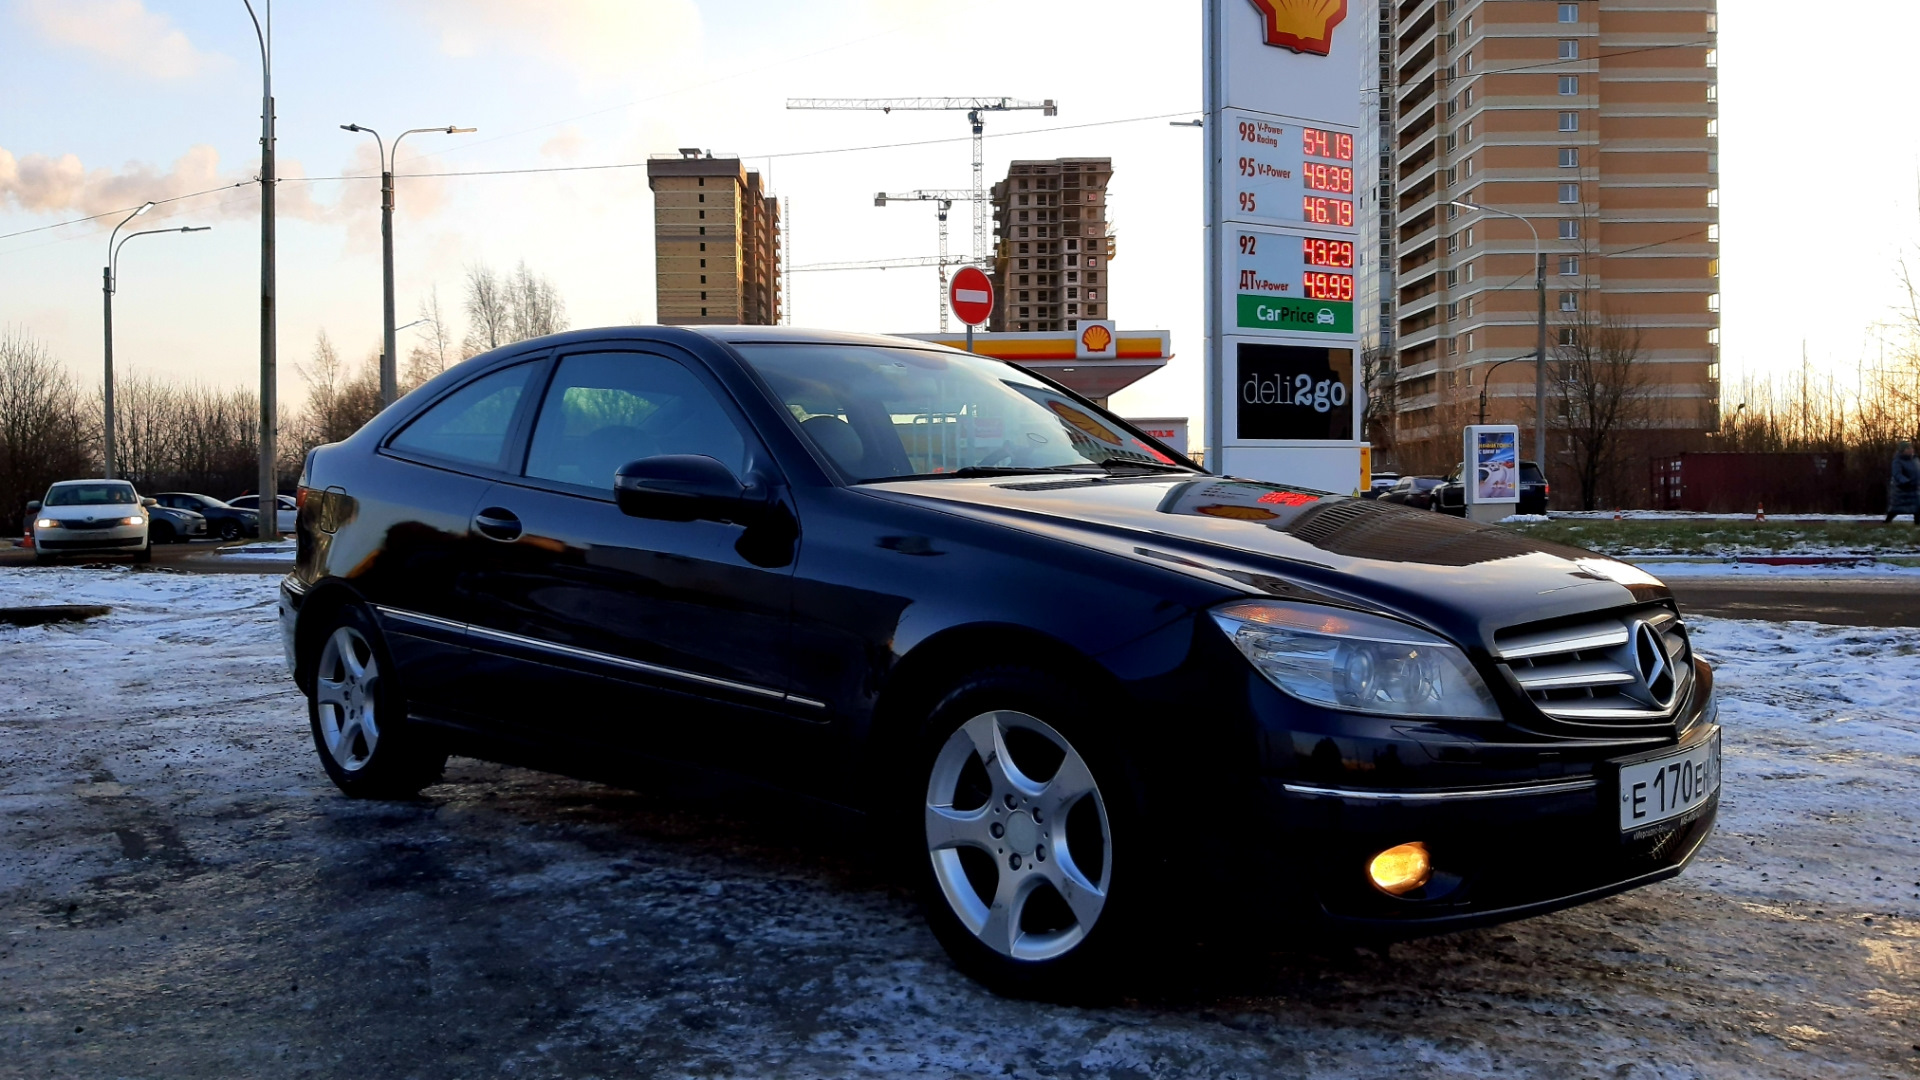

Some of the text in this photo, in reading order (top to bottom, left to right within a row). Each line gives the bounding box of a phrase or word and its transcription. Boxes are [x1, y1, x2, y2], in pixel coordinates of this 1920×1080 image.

[1239, 121, 1283, 143] 98 V-Power
[1257, 134, 1278, 147] Racing
[1303, 128, 1352, 160] 54.19
[1239, 157, 1291, 179] 95 V-Power
[1303, 162, 1352, 193] 49.39
[1239, 192, 1256, 212] 95
[1303, 196, 1352, 226] 46.79
[1239, 235, 1256, 255] 92
[1303, 239, 1352, 267] 43.29
[1239, 269, 1289, 291] ДТ V-Power
[1303, 272, 1352, 300] 49.99
[1256, 304, 1315, 323] CarPrice
[1243, 373, 1346, 413] deli2go
